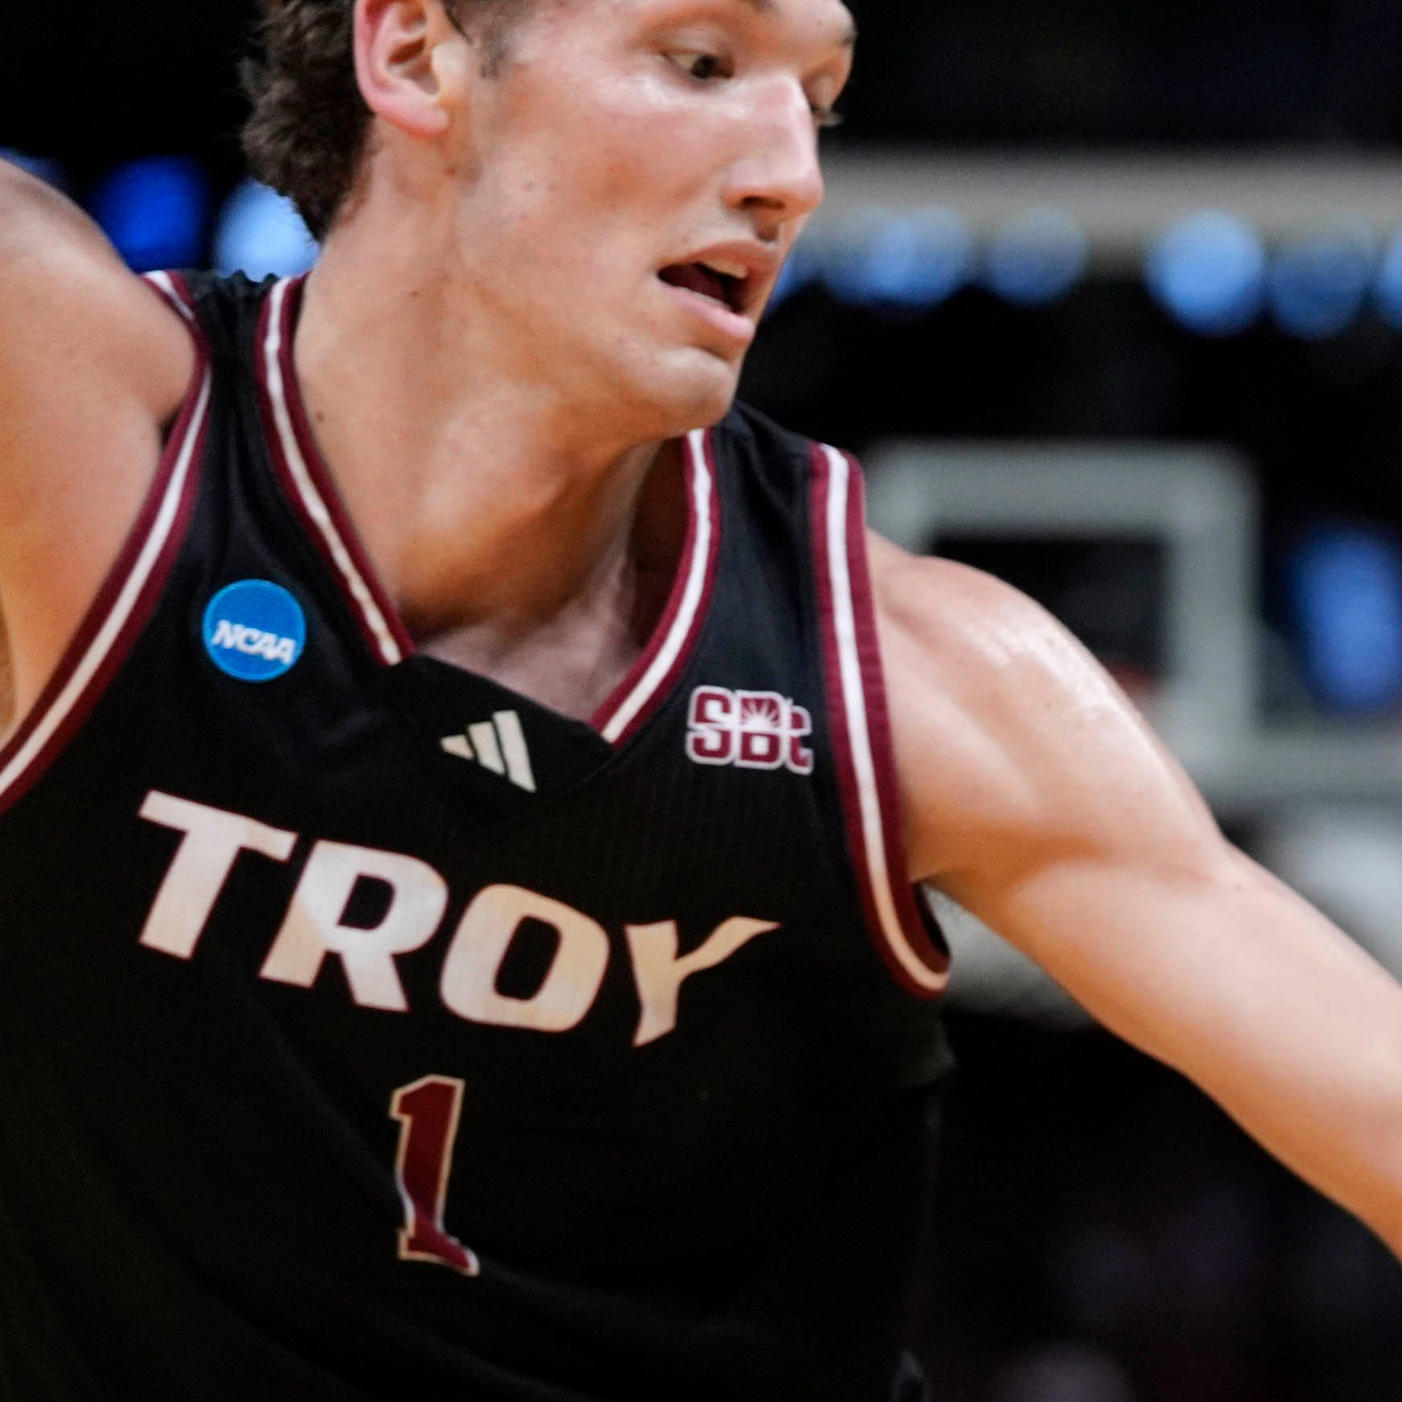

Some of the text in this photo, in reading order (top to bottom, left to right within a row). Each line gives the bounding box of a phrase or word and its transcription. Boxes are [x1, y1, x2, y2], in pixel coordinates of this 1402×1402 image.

[212, 618, 297, 666] NCAA
[138, 789, 783, 1048] TROY
[388, 1073, 481, 1276] 1
